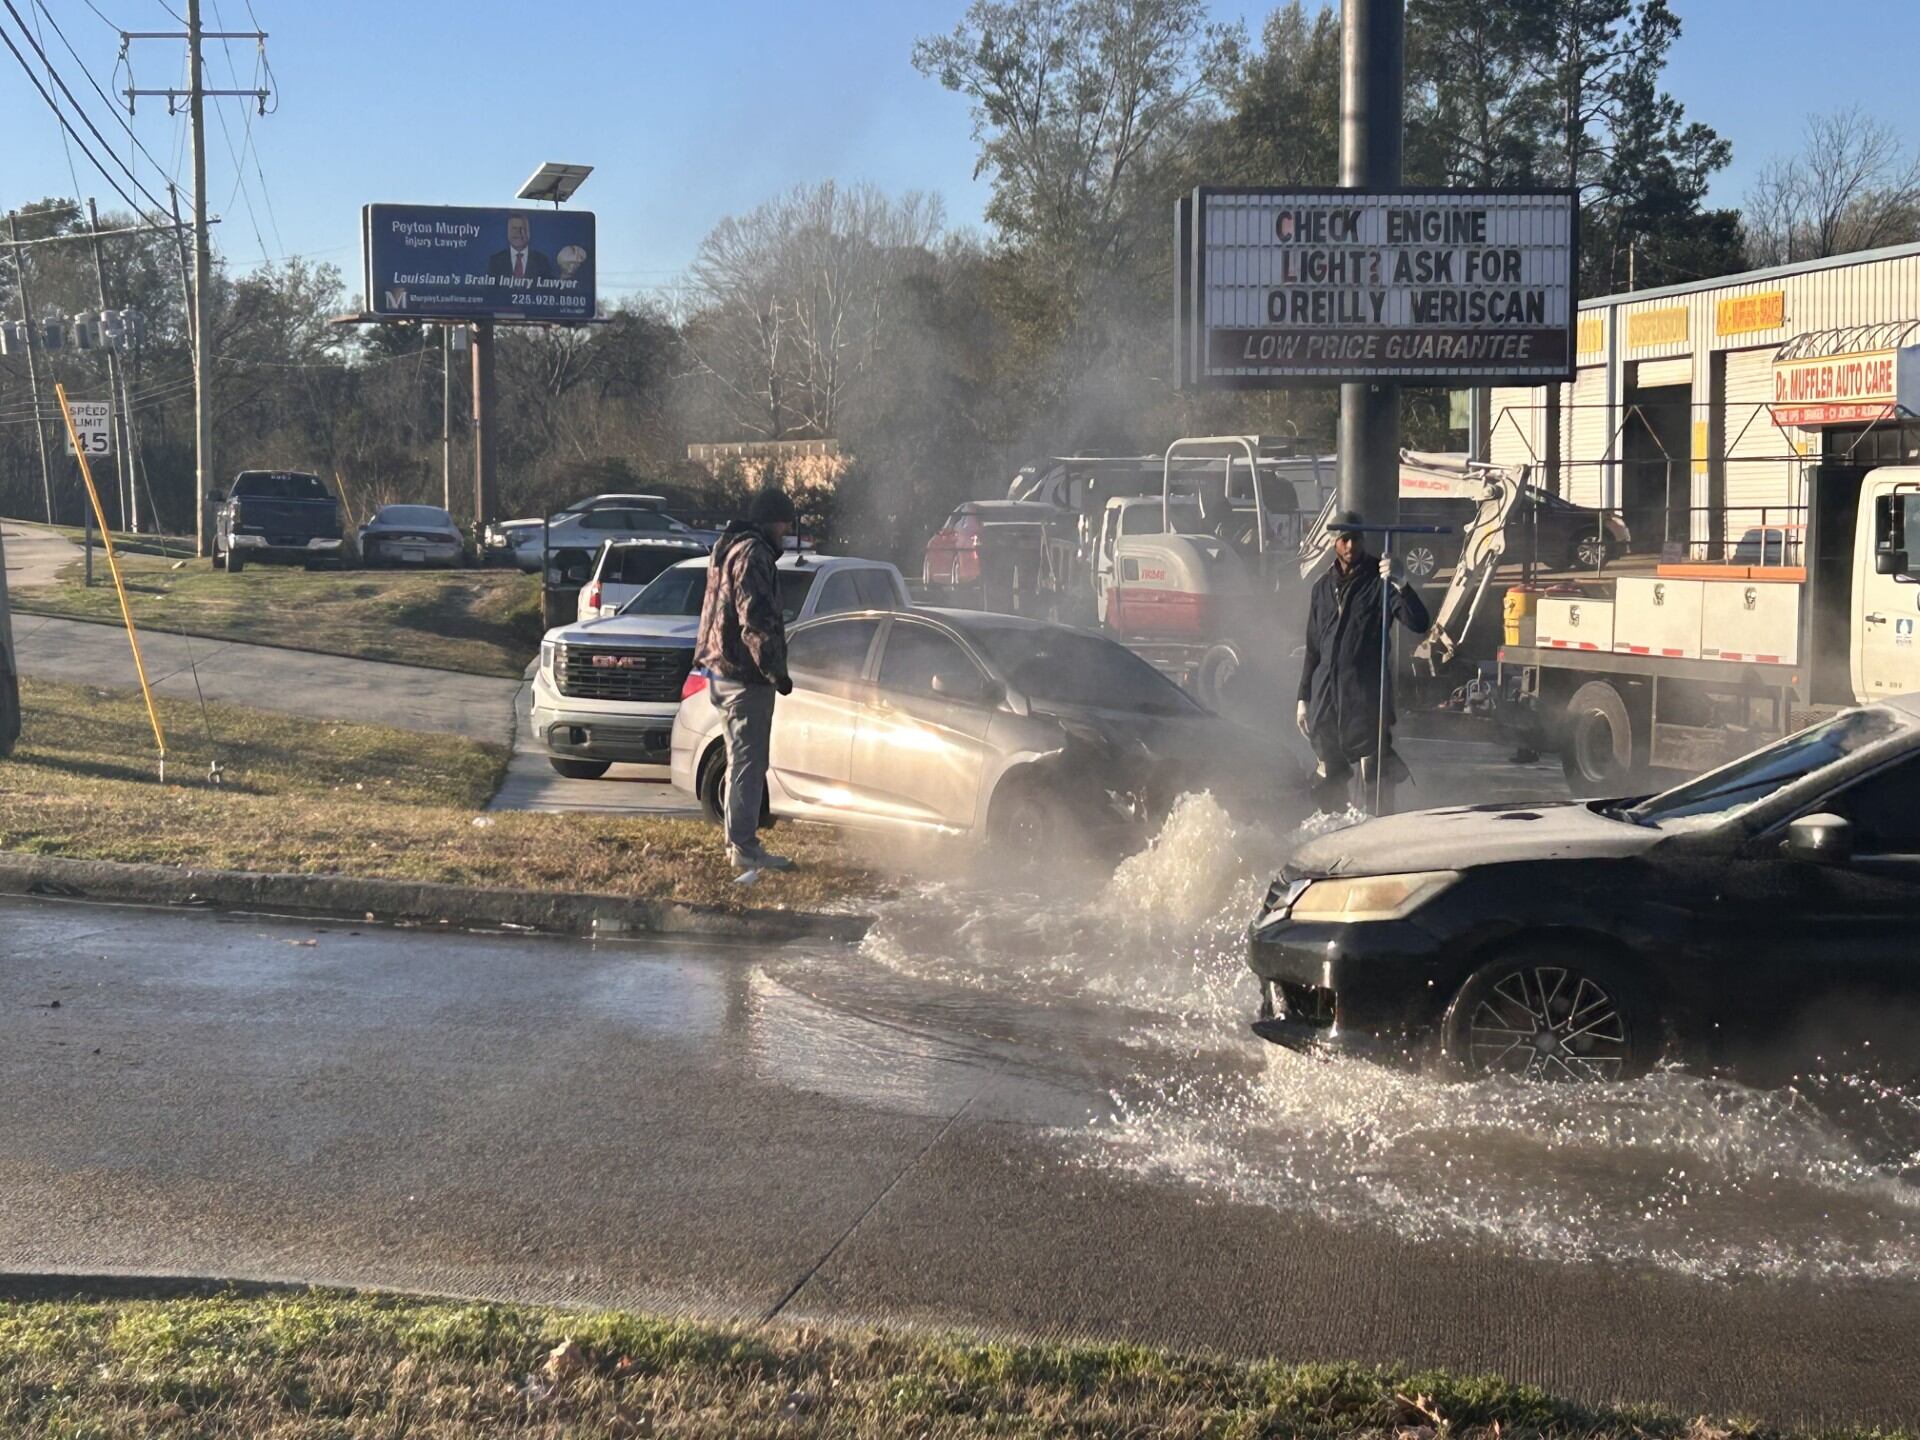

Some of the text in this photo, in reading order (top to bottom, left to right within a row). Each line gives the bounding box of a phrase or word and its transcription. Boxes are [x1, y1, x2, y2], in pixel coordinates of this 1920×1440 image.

[392, 221, 480, 238] Peyton Murphy
[1276, 210, 1486, 243] CHECK ENGINE
[434, 237, 467, 248] Lawyer
[1282, 250, 1522, 285] LIGHT? ASK FOR
[393, 271, 578, 290] Louisiana's Brain Injury Lawyer
[1268, 290, 1544, 324] OREILLY VERISCAN
[1244, 335, 1534, 360] LOW PRICE GUARANTEE
[1776, 360, 1892, 401] Dr. MUFFLER AUTO CARE
[69, 407, 108, 416] SPEED
[73, 418, 104, 427] LIMIT
[592, 655, 646, 668] GMC
